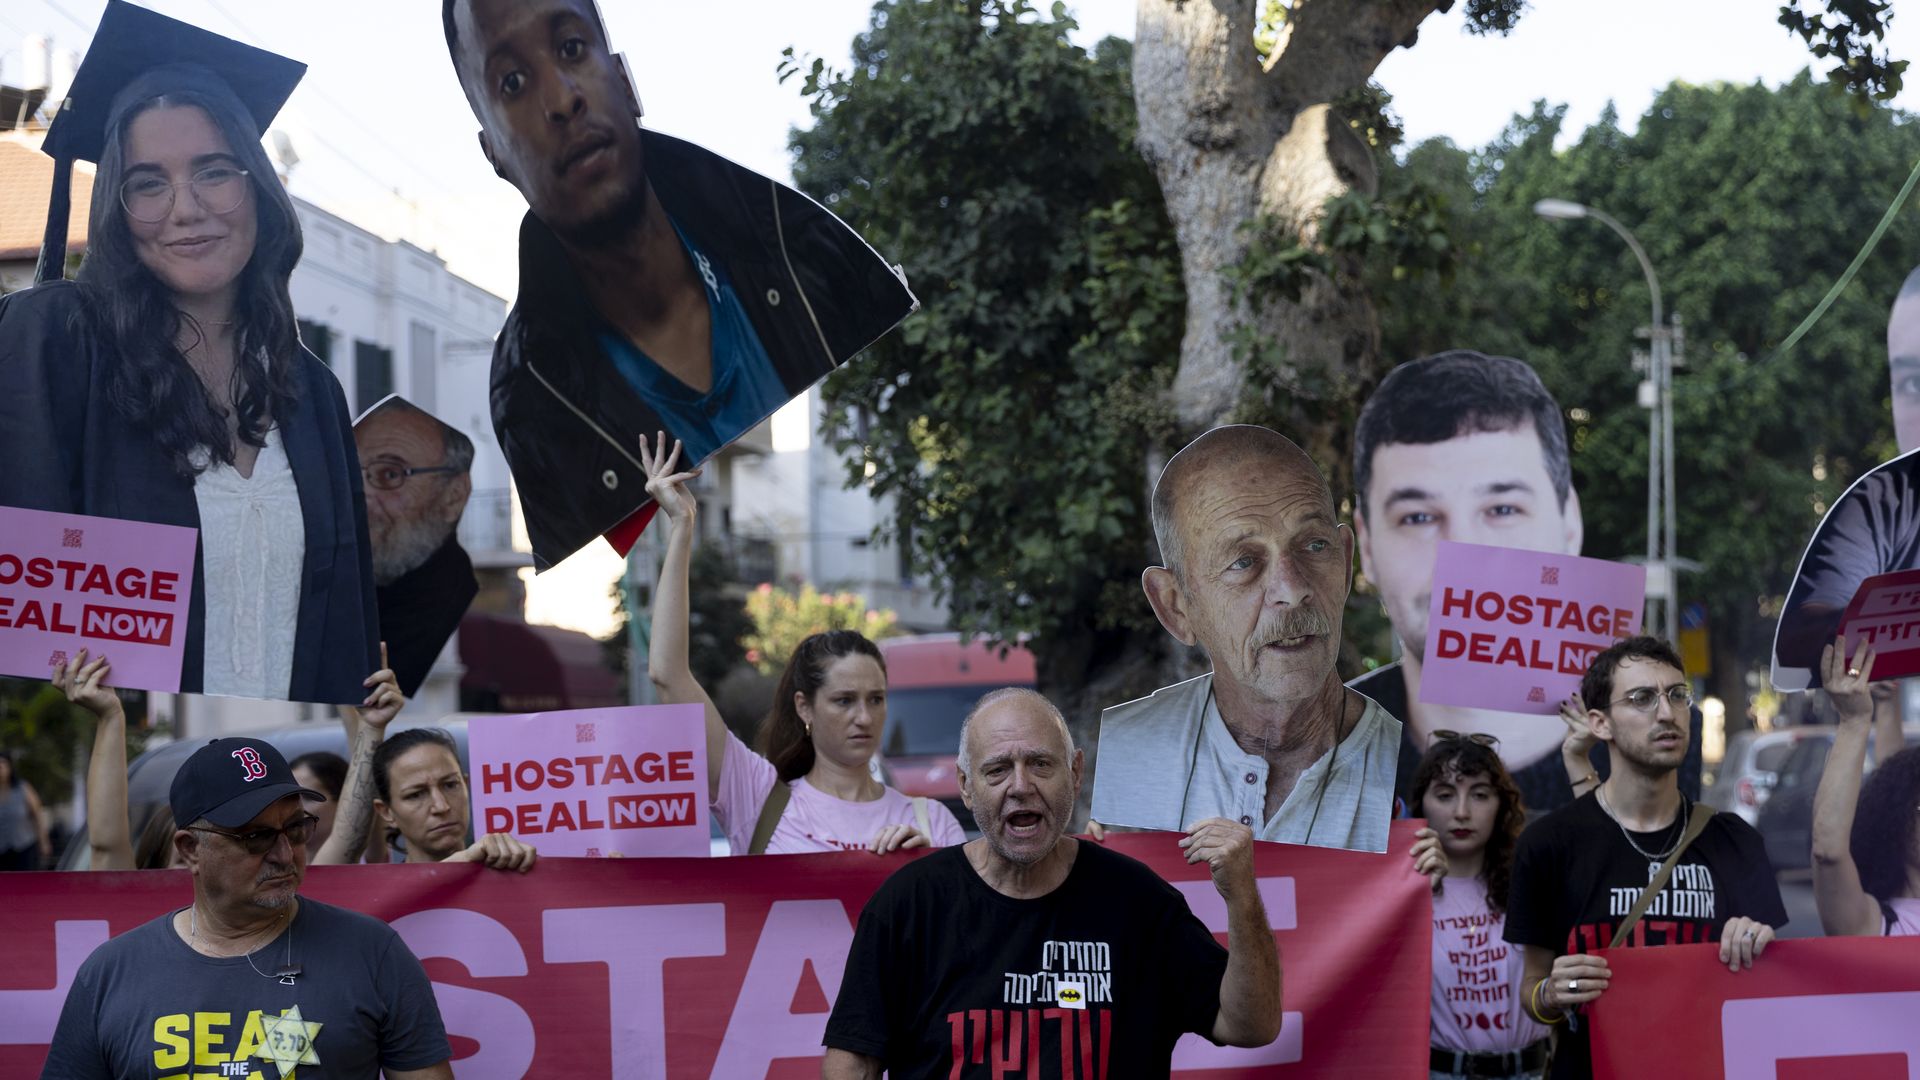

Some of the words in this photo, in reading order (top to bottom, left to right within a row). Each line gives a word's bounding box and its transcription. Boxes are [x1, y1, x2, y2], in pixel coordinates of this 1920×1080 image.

[87, 609, 168, 640] NOW
[1441, 587, 1634, 637] HOSTAGE
[1436, 629, 1554, 670] DEAL
[231, 746, 267, 782] B
[482, 751, 695, 794] HOSTAGE
[485, 800, 604, 835] DEAL
[615, 798, 690, 824] NOW
[1672, 889, 1715, 919] אותם
[1042, 940, 1111, 971] מחזירים
[1462, 932, 1489, 949] עד
[153, 1009, 293, 1070] SEA
[221, 1061, 250, 1076] THE
